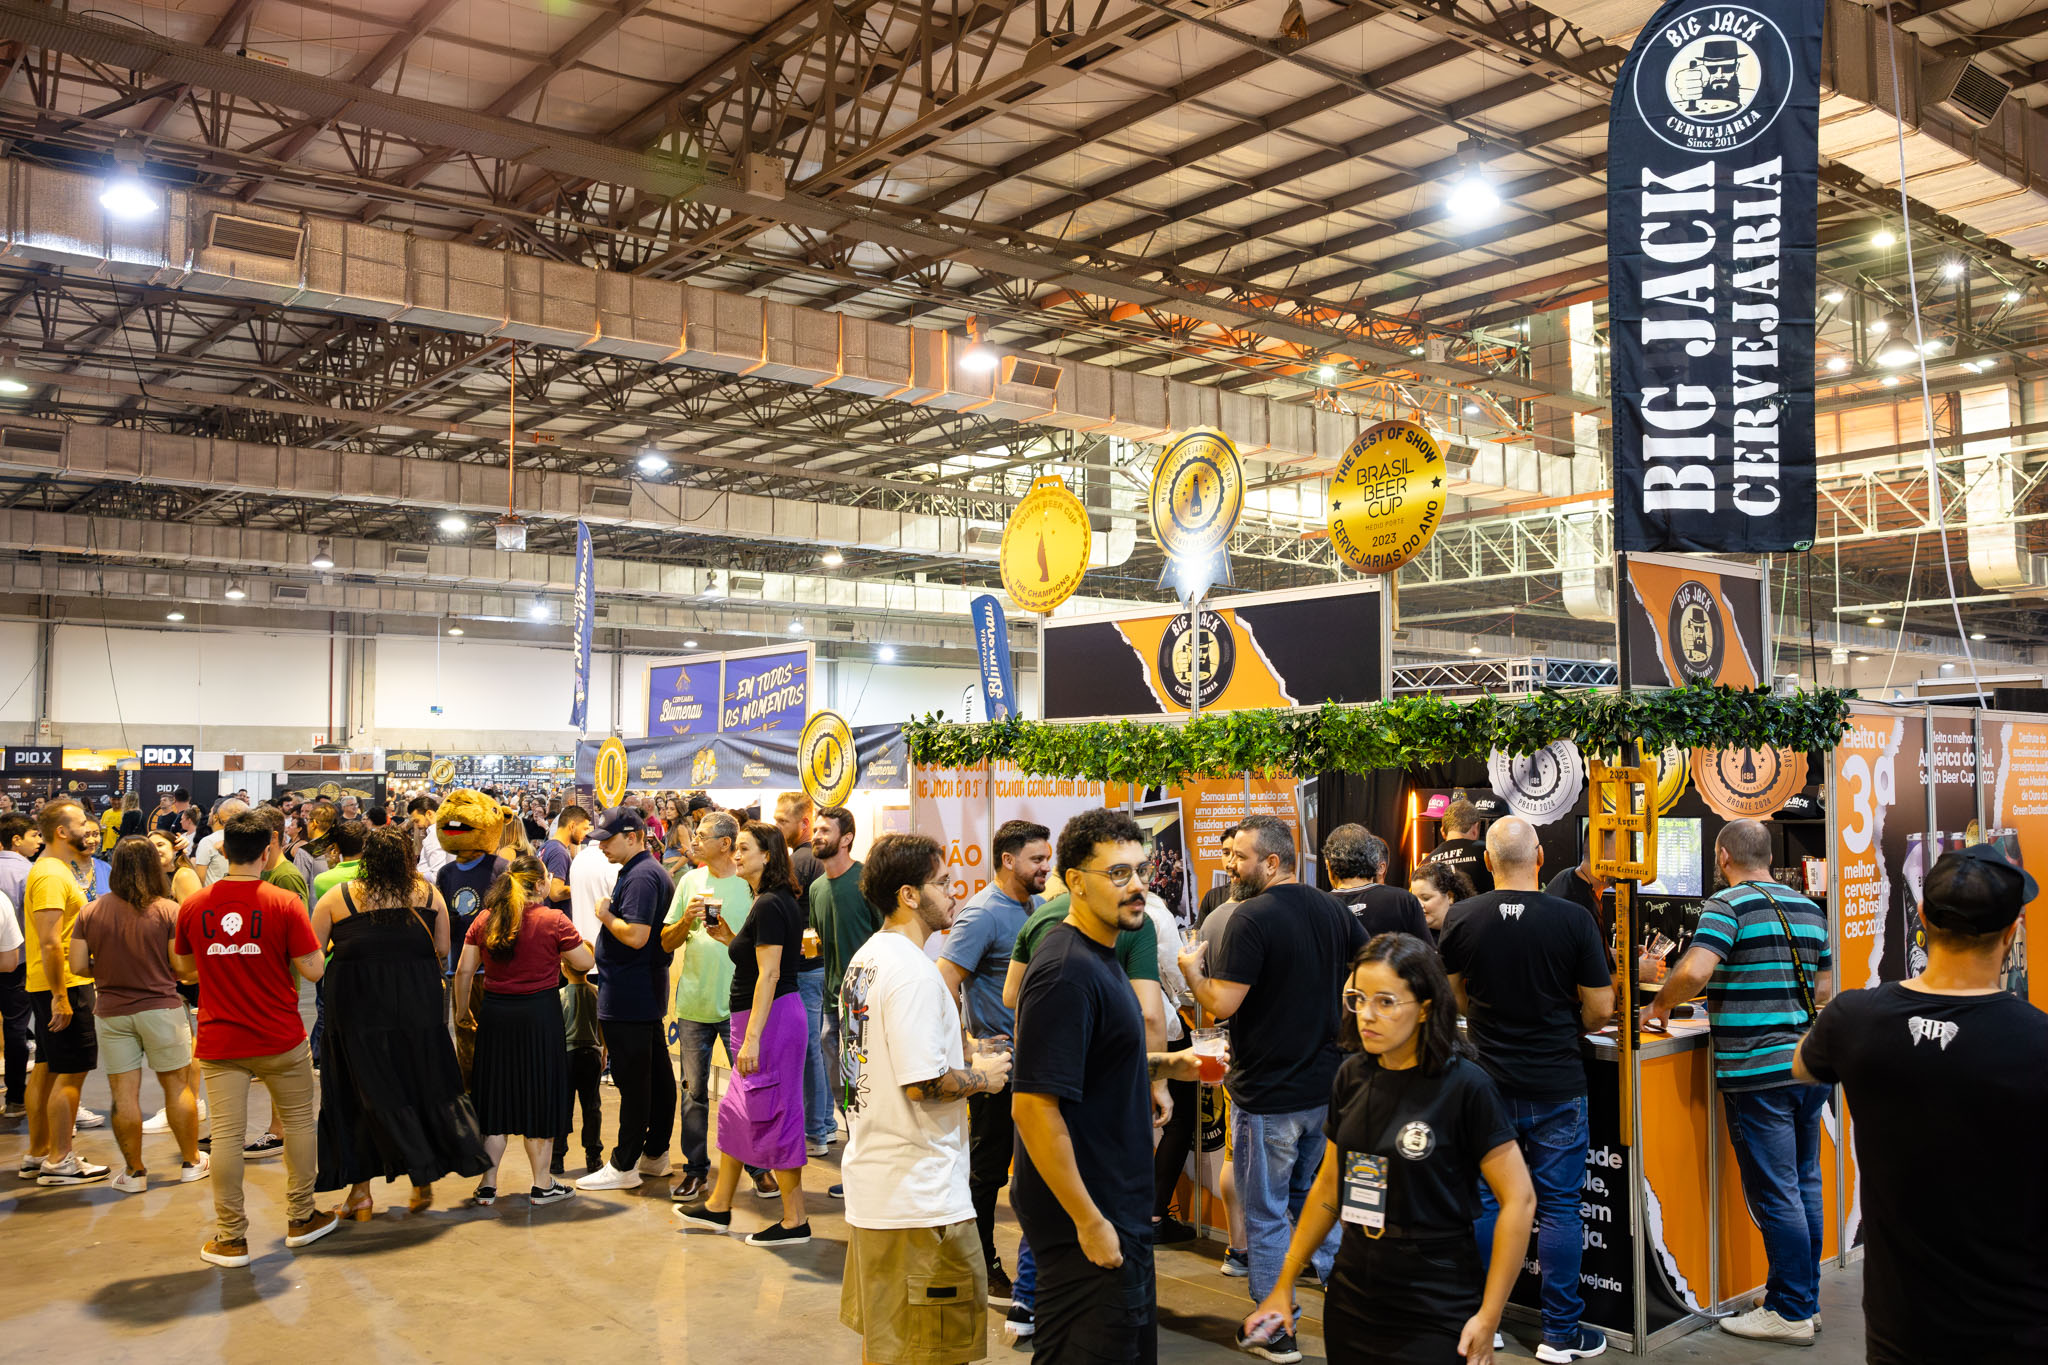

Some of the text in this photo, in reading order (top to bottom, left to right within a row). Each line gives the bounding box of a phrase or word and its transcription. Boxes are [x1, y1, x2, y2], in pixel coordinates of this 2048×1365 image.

[1665, 10, 1764, 48] BIG JACK
[1666, 110, 1762, 138] CERVEJARIA
[1686, 136, 1738, 148] Since 2011
[1640, 160, 1717, 514] BIG JACK
[1732, 155, 1783, 517] CERVEJARIA
[1334, 426, 1438, 484] THE BEST OF SHOW
[1356, 457, 1415, 486] BRASIL
[1364, 476, 1407, 502] BEER
[1016, 499, 1078, 531] SOUTH BEER CUP
[1367, 496, 1403, 518] CUP
[1333, 500, 1438, 568] CERVEJARIAS DO ANO
[1372, 532, 1397, 547] 2023
[1015, 574, 1071, 598] THE CHAMPIONS
[1677, 586, 1713, 612] BIG JACK
[1171, 612, 1220, 637] BIG ACK
[980, 628, 989, 677] CERVEJARIA
[736, 662, 793, 700] EM TODOS
[1174, 681, 1218, 698] CERVJARIA
[659, 699, 703, 723] Blumenau
[724, 683, 805, 728] OS MOMENTOS
[315, 735, 324, 745] H
[1877, 732, 1886, 749] a
[1933, 731, 1947, 744] leita
[1947, 735, 1952, 743] a
[1952, 732, 1973, 744] melhor
[15, 752, 52, 764] PIO X
[145, 748, 193, 764] PIO X
[1553, 742, 1571, 774] CERVEJAS
[1962, 747, 1976, 767] do
[1743, 772, 1754, 780] CBC
[1919, 769, 1994, 787] Soth Beer Cup 023
[157, 784, 179, 793] PIO X
[1201, 791, 1225, 801] Somos
[1226, 792, 1237, 801] um
[1257, 791, 1277, 801] unido
[1195, 804, 1295, 818] uma paixão cevejeira, pelas
[1518, 798, 1556, 812] PRATA 2024
[1726, 795, 1773, 811] BRONZE 2024
[1193, 819, 1224, 829] histórias
[1617, 817, 1638, 827] Lugar
[941, 839, 982, 867] ÃO
[1430, 848, 1464, 864] STAFF
[1595, 863, 1648, 876] Melhor Cervejaria
[1844, 860, 1876, 879] melhor
[1844, 878, 1890, 899] cervejaria
[1845, 894, 1883, 917] do Brasil
[1845, 917, 1885, 938] CBC 2023
[1202, 1127, 1222, 1140] JARIA
[1579, 1273, 1622, 1293] vejaria
